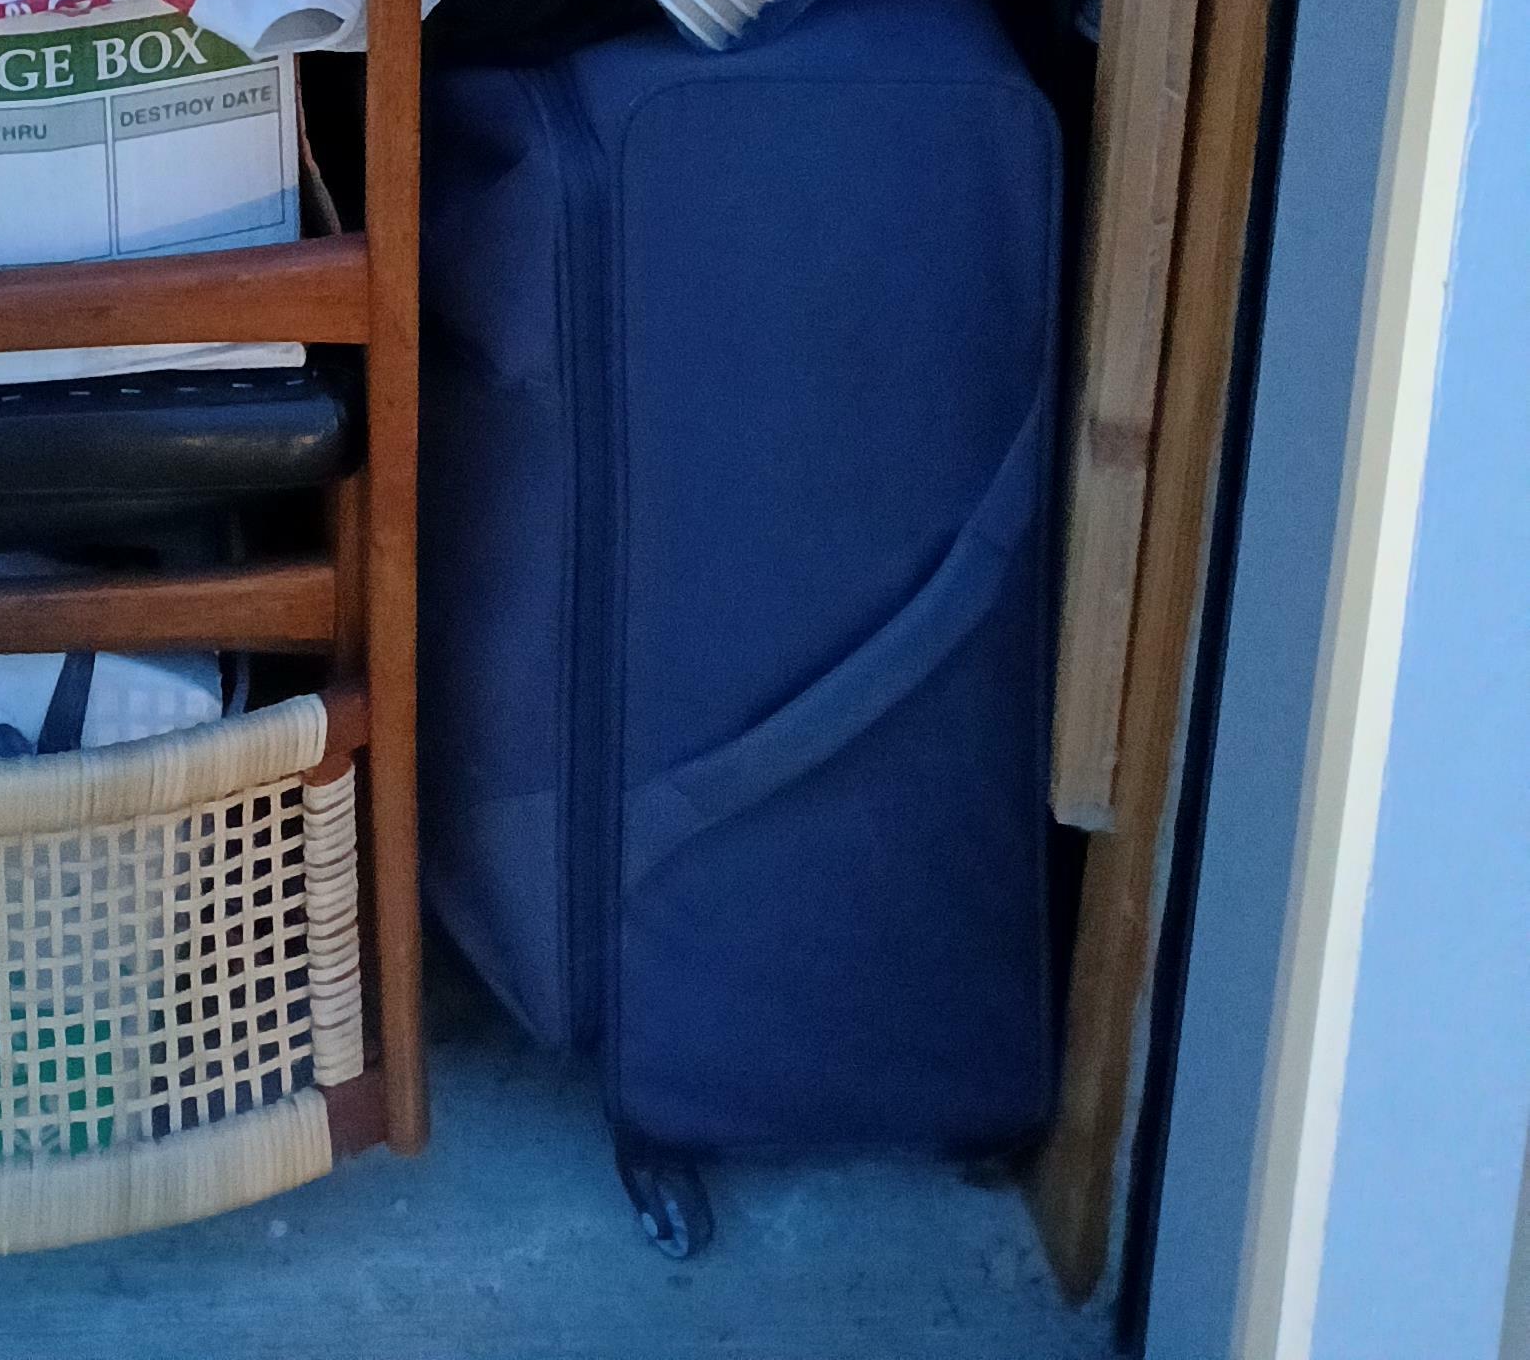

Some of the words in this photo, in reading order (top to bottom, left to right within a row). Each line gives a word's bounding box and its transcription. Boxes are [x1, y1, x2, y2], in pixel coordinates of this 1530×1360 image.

[94, 23, 210, 82] BOX
[118, 95, 216, 129] DESTROY
[222, 84, 273, 110] DATE
